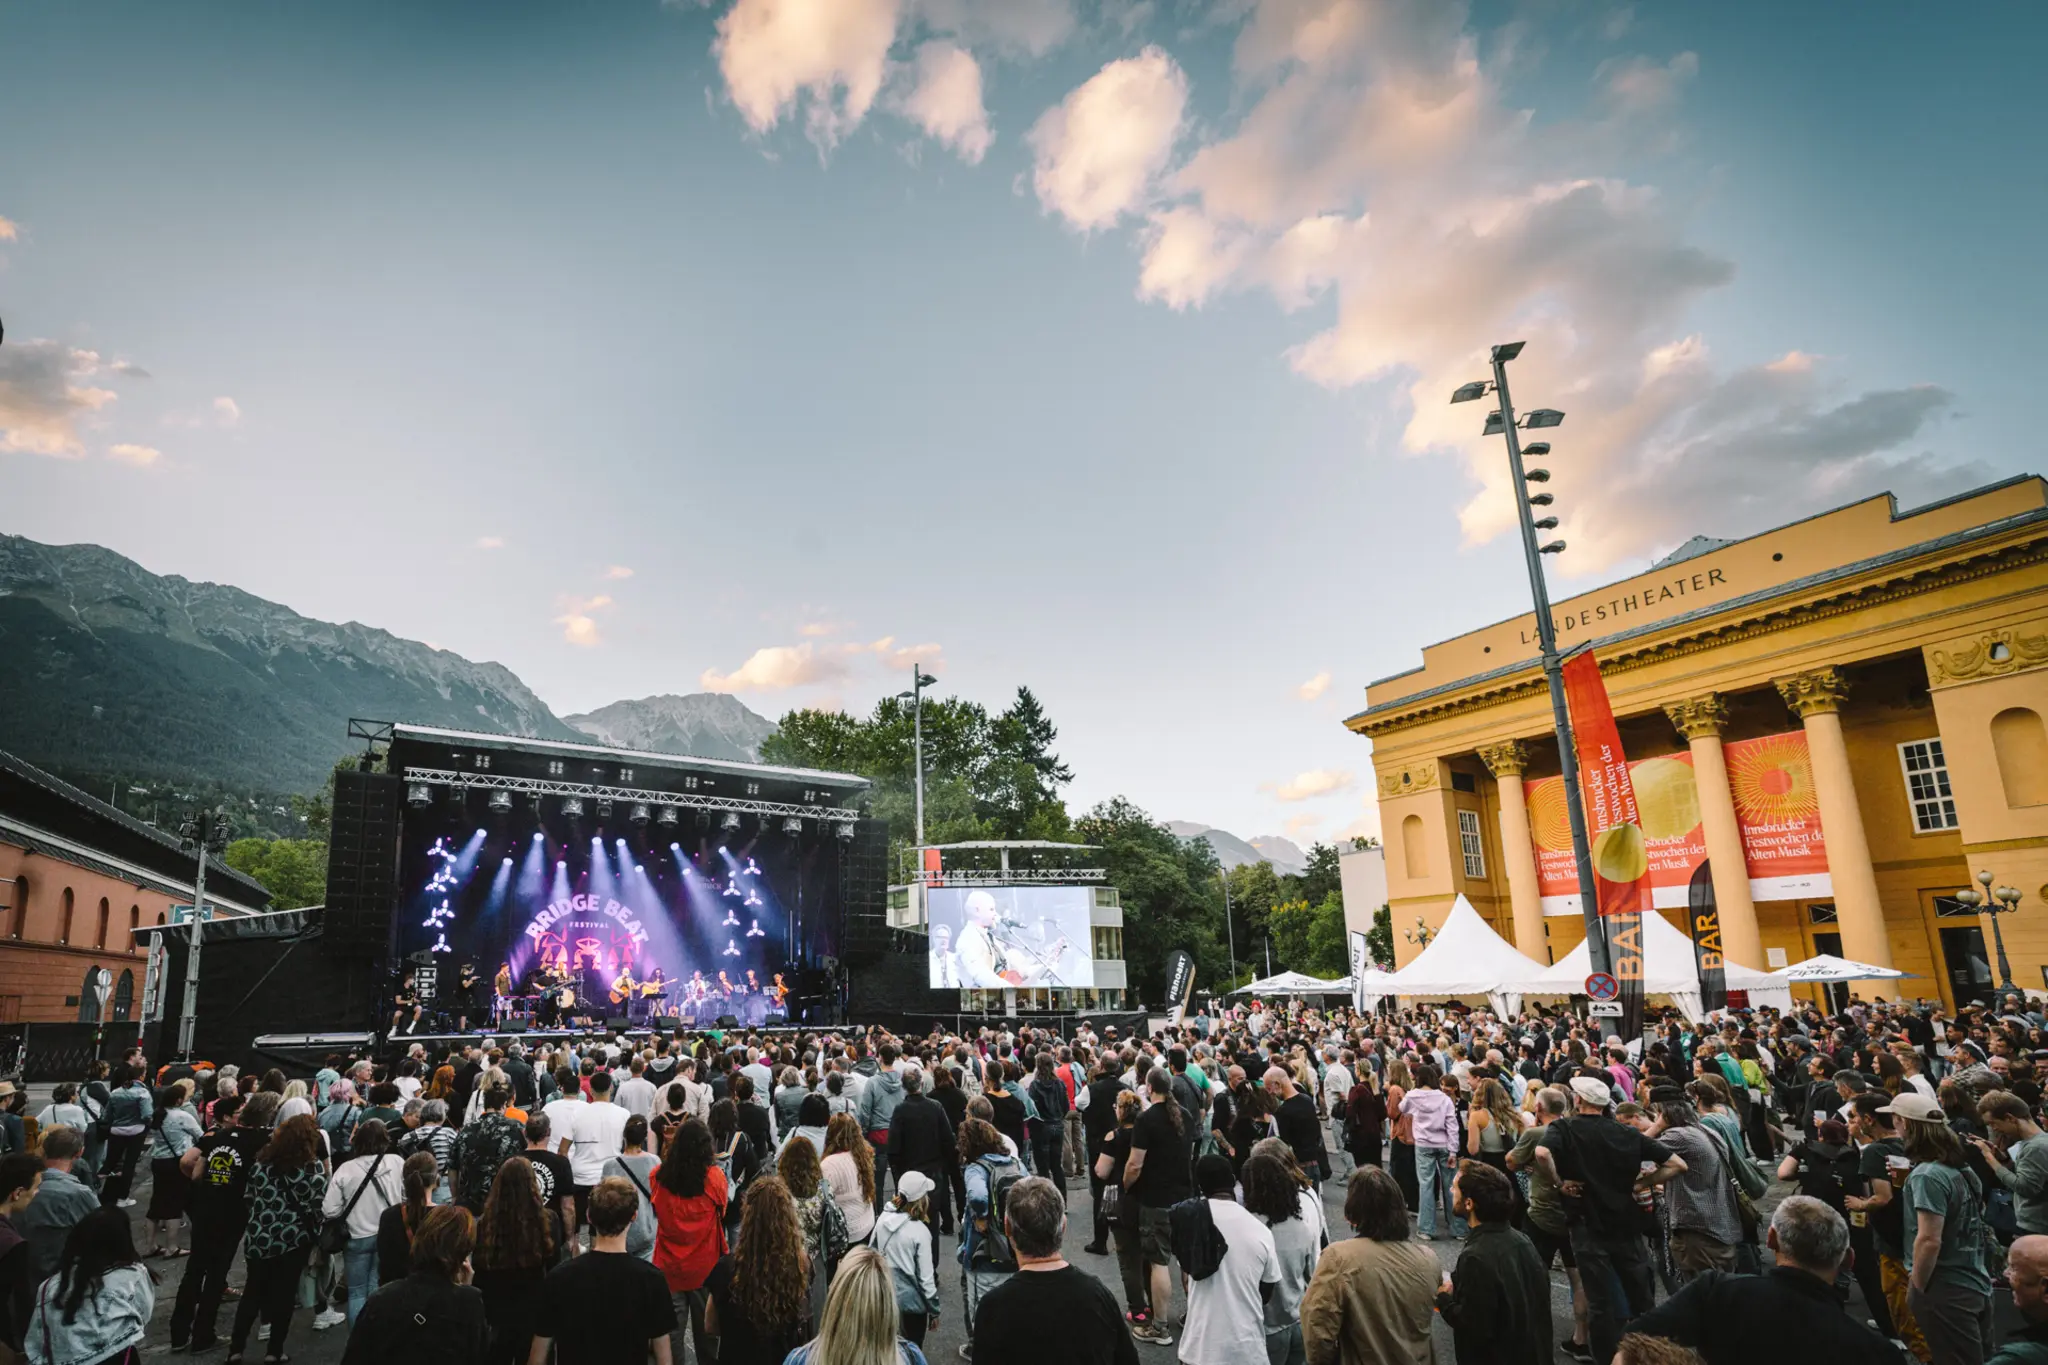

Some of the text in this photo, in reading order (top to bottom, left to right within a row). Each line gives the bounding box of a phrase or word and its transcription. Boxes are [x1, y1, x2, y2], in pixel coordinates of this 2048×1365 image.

[1520, 568, 1727, 645] LANDESTHEATER
[1600, 744, 1624, 830] Festwochen der
[1616, 761, 1638, 825] Alten Musik
[1588, 768, 1609, 833] Innsbrucker
[1743, 819, 1806, 836] Innsbrucker
[1746, 829, 1824, 848] Festwochen de
[1690, 843, 1706, 855] der
[1748, 843, 1812, 861] Alten Musik
[1540, 858, 1578, 871] Festwoch
[1662, 857, 1690, 869] Musik
[525, 894, 650, 943] BRIDGE BEAT
[569, 921, 610, 929] FESTIVAL
[1695, 911, 1724, 970] BAR
